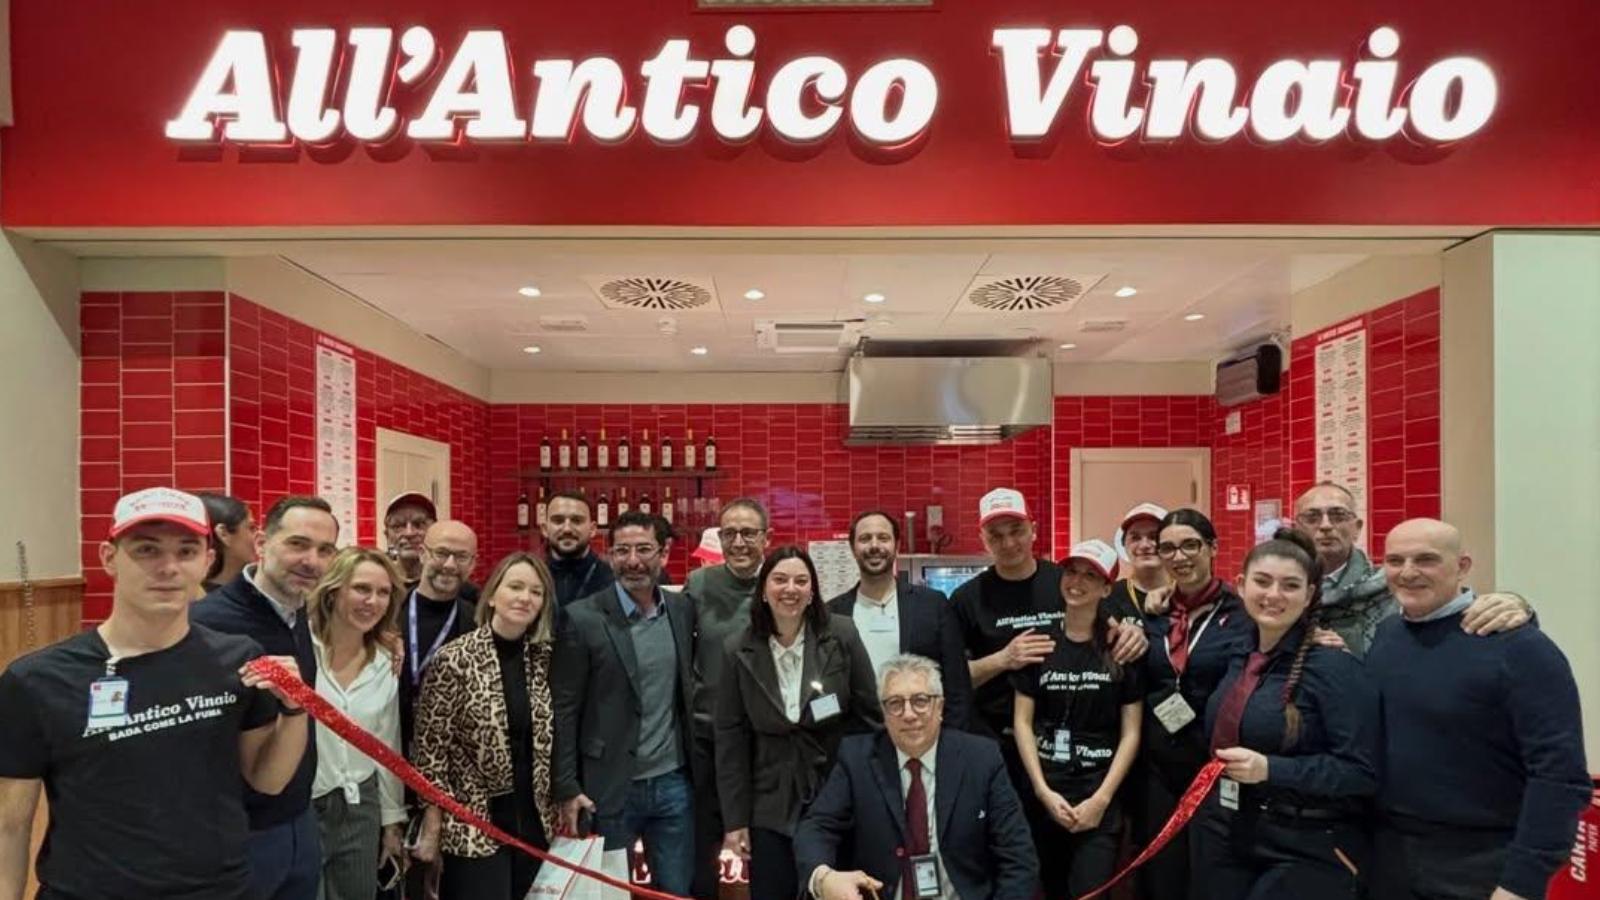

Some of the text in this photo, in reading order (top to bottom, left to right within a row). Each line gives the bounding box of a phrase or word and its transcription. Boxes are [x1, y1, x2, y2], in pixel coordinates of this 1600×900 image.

[165, 25, 1499, 143] All'Antico Vinaio
[185, 691, 237, 711] Vinaio
[108, 726, 142, 742] BADA
[143, 717, 176, 732] COME
[178, 713, 193, 724] LA
